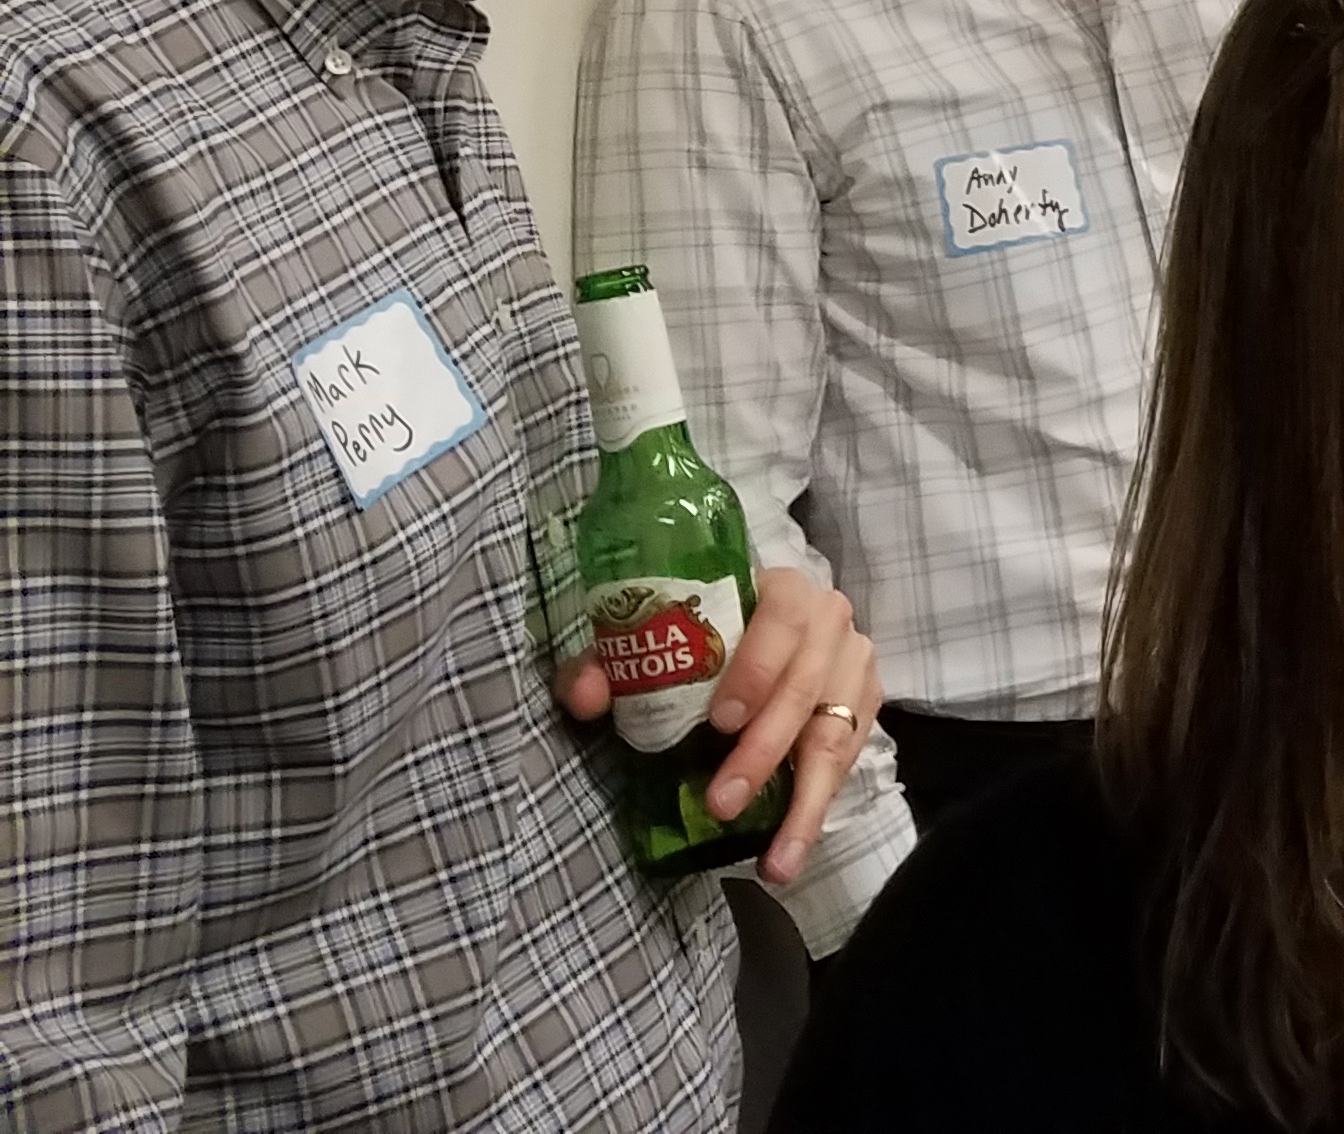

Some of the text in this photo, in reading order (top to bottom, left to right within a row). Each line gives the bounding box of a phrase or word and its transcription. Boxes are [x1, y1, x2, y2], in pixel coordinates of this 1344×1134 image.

[962, 188, 1070, 233] Doherty
[307, 345, 381, 413] Mark
[331, 403, 413, 467] Perry
[597, 624, 689, 658] STELLA
